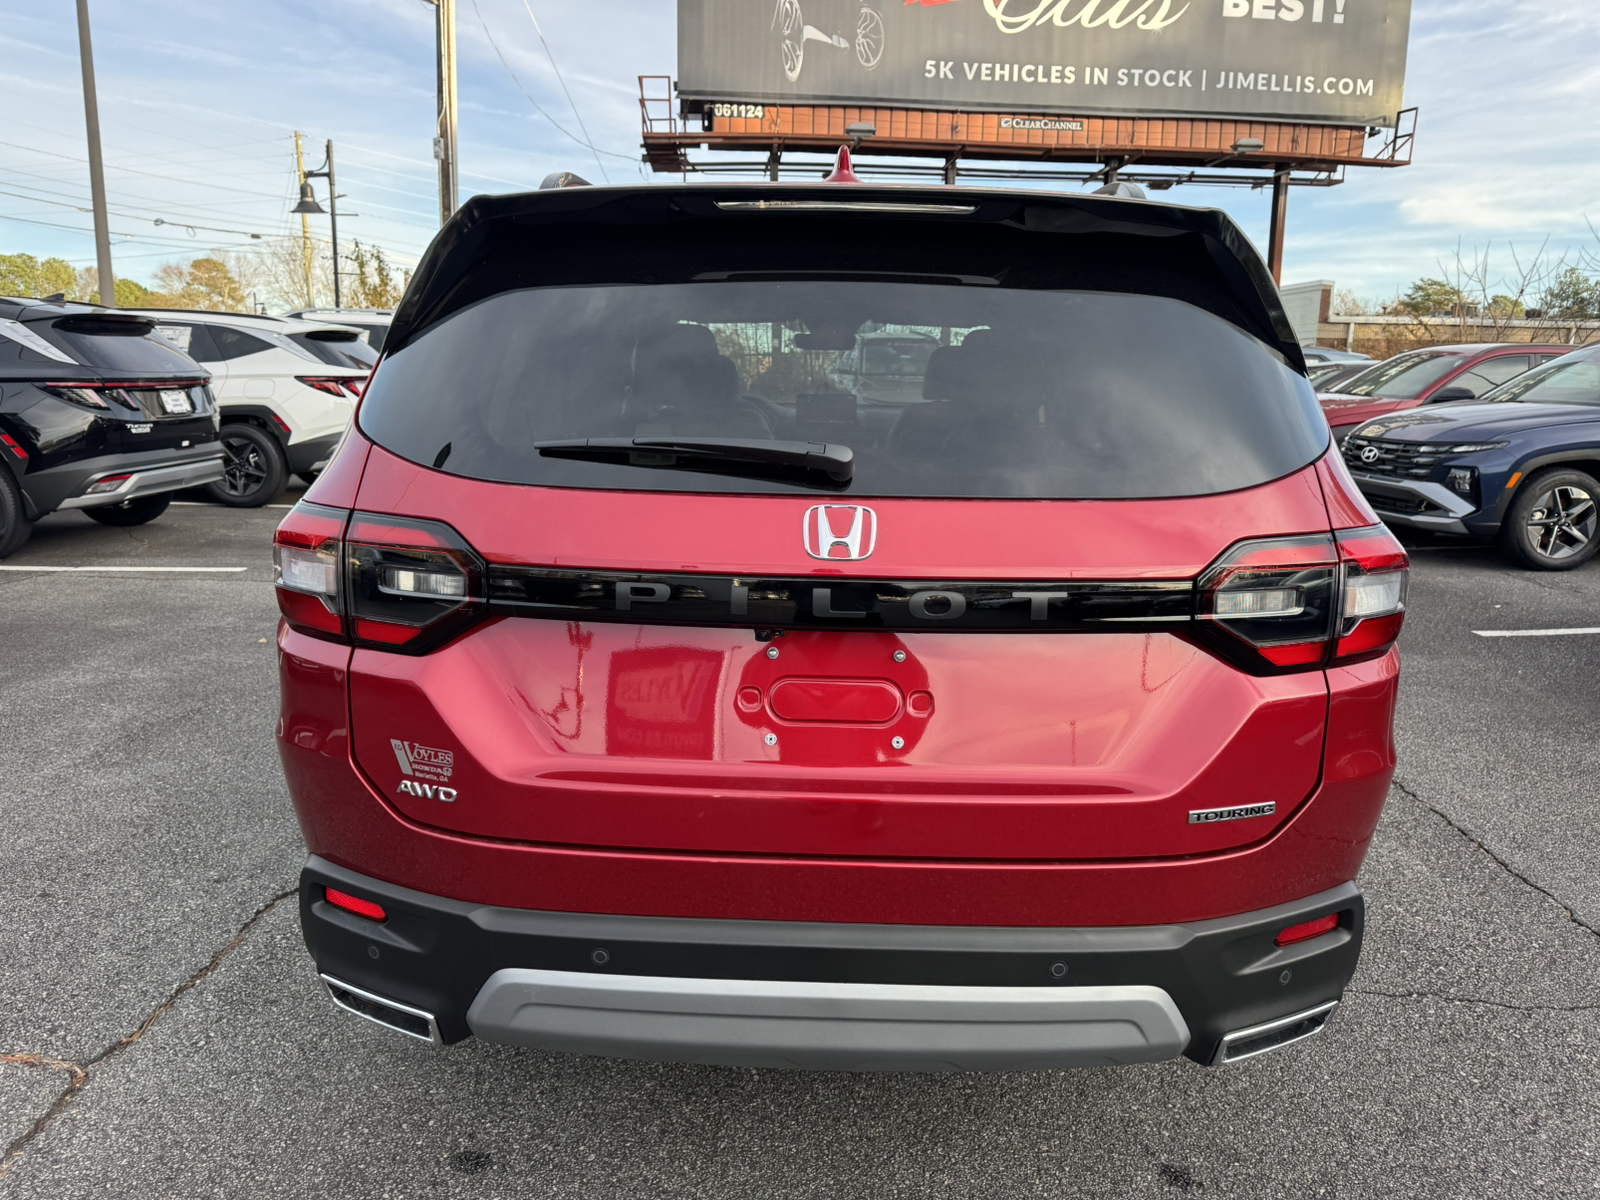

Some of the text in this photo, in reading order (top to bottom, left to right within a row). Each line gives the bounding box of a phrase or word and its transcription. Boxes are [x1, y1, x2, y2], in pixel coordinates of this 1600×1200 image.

[924, 60, 954, 80] 5K
[963, 61, 1076, 85] VEHICLES
[1084, 66, 1109, 86] IN
[1116, 68, 1193, 88] STOCK
[1216, 70, 1374, 97] JIMELLIS.COM
[714, 103, 764, 119] 061124
[615, 580, 1068, 621] PILOT
[402, 741, 452, 765] VOYLES
[411, 763, 443, 774] HONDA
[396, 780, 458, 803] AWD
[1192, 803, 1275, 822] TOURING
